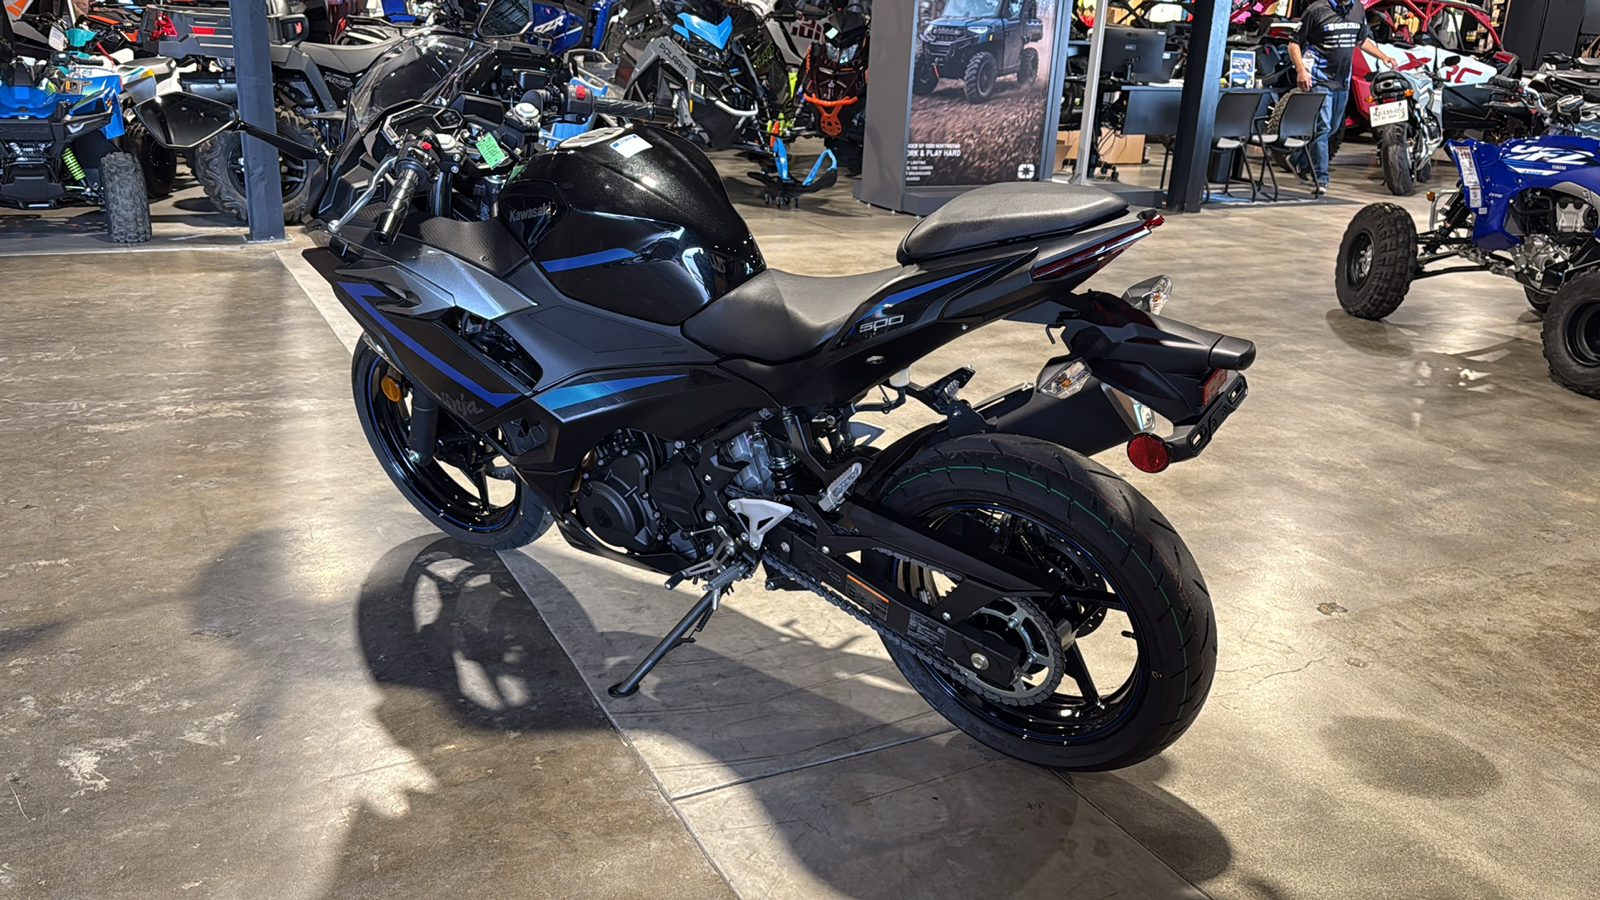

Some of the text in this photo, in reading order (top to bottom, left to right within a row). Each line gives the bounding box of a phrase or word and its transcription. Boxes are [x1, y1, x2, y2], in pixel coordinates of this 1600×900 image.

[659, 42, 689, 74] POLARIS
[907, 149, 961, 157] ORK & PLAY HARD
[509, 201, 552, 222] Kawasaki
[859, 314, 904, 333] 500
